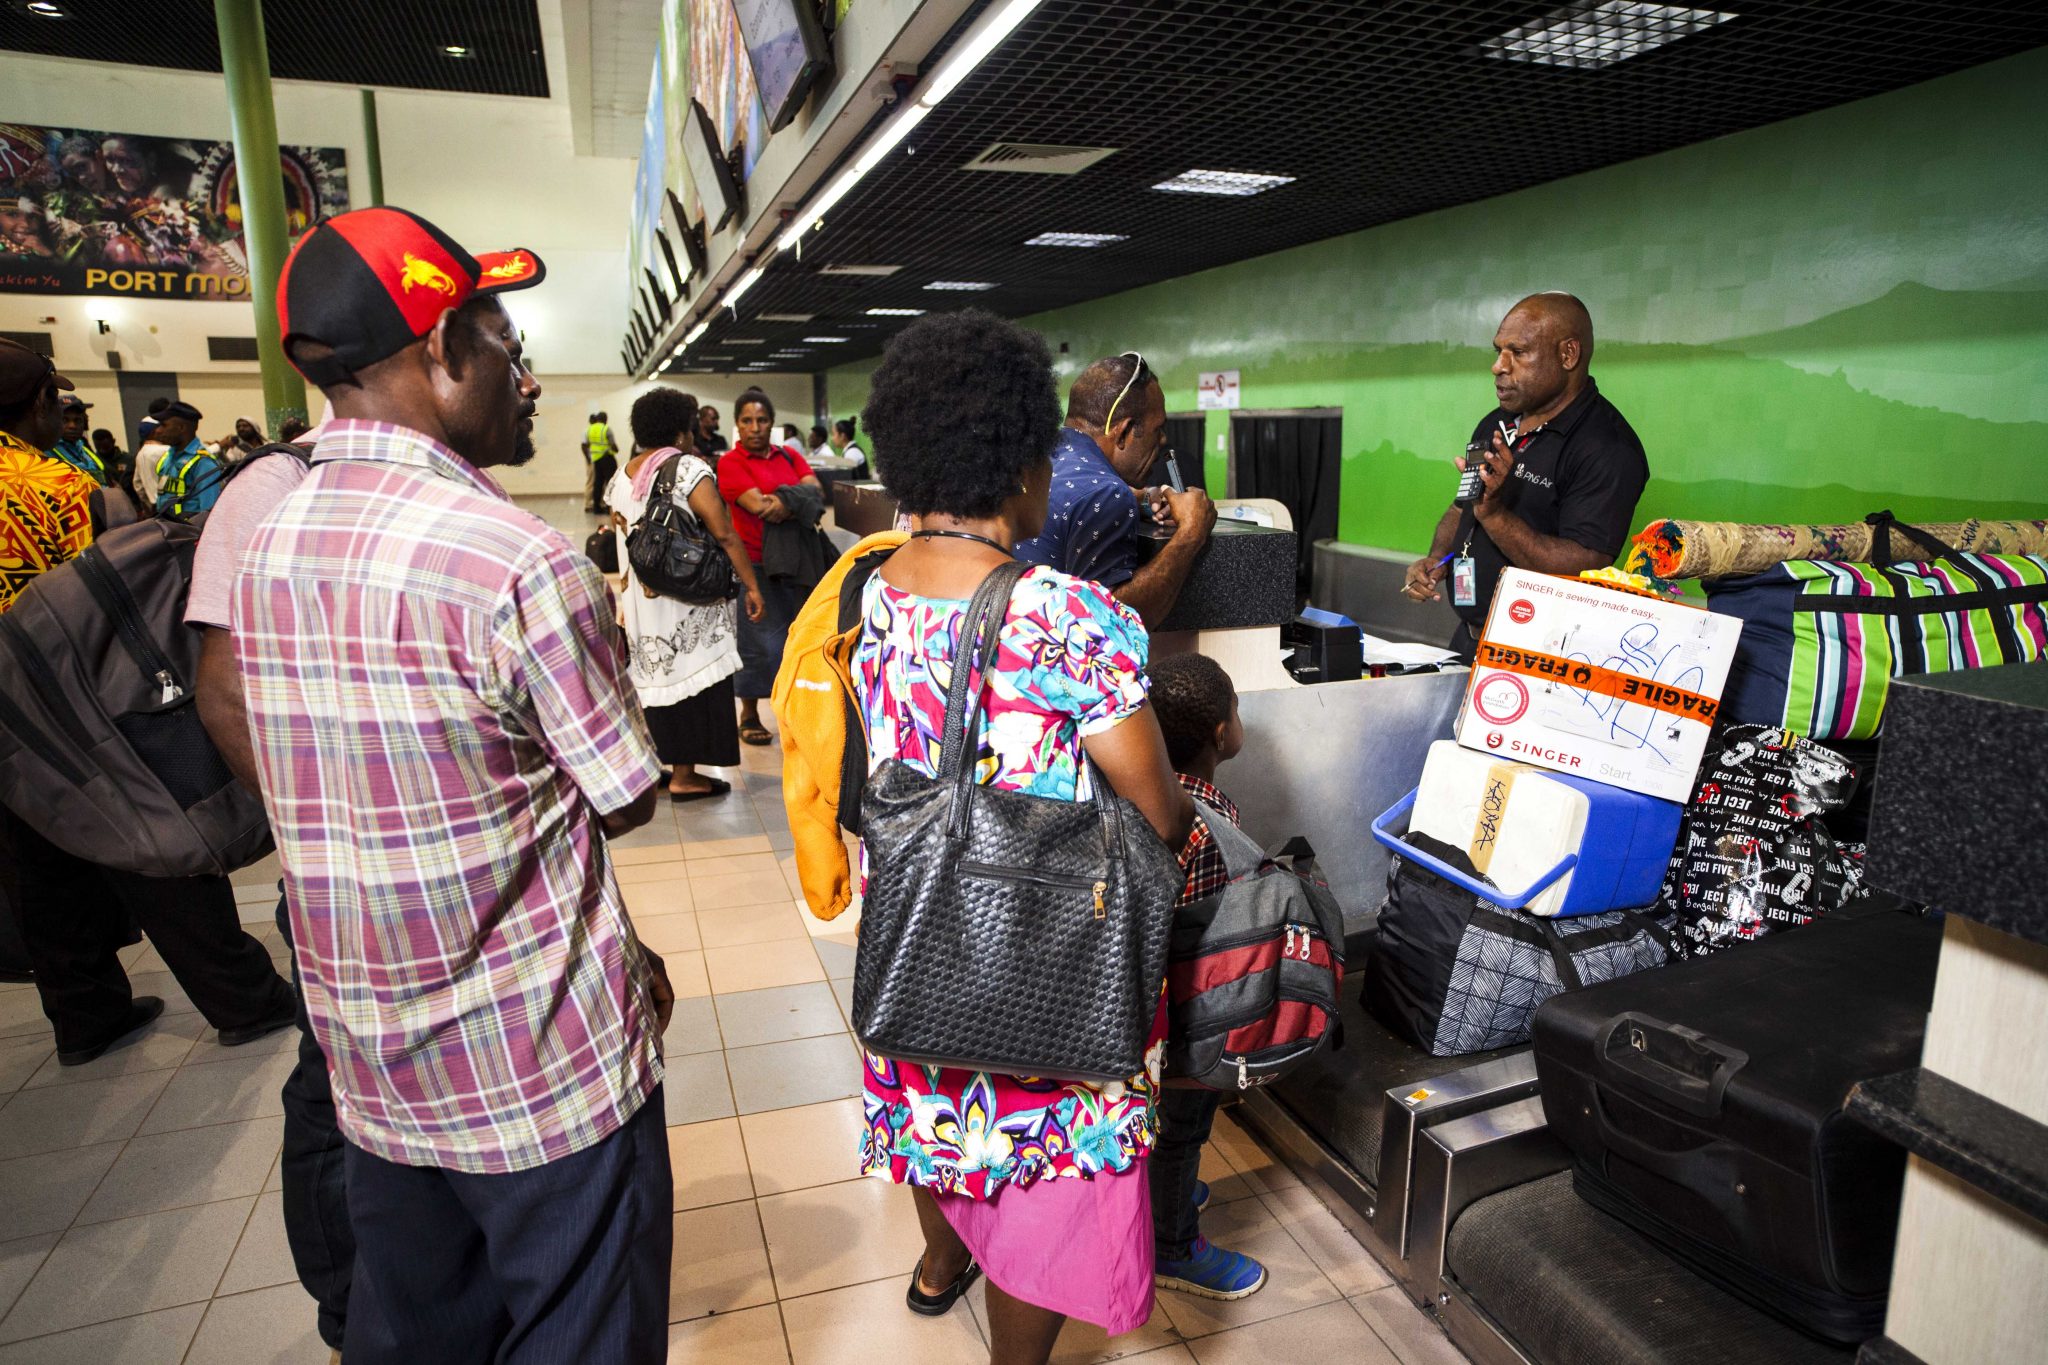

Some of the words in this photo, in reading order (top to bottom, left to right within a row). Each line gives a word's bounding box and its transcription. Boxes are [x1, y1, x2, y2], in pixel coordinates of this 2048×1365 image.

[86, 268, 179, 293] PORT
[1523, 471, 1541, 484] PNG
[1516, 580, 1554, 597] SINGER
[1555, 590, 1564, 598] is
[1565, 593, 1599, 608] sewing
[1601, 600, 1629, 613] made
[1484, 645, 1569, 677] FRAGIL
[1757, 749, 1780, 761] FIVE
[1814, 744, 1837, 759] FIVE
[1511, 740, 1582, 768] SINGER
[1599, 763, 1633, 781] Start
[1712, 771, 1733, 781] JECI
[1734, 775, 1757, 786] FIVE
[1762, 773, 1786, 786] JECI
[1788, 780, 1810, 795] FIVE
[1723, 795, 1753, 811] JECI
[1731, 813, 1756, 826] FIVE
[1758, 819, 1782, 832] JECI
[1710, 822, 1721, 833] by
[1789, 844, 1811, 857] FIVE
[1693, 861, 1710, 873] JECI
[1712, 863, 1735, 877] FIVE
[1774, 856, 1797, 871] FIVE
[1799, 862, 1815, 875] ECI
[1683, 883, 1700, 895] JEC
[1757, 881, 1781, 896] FIVE
[1703, 890, 1724, 903] JECI
[1766, 907, 1790, 922] JECI
